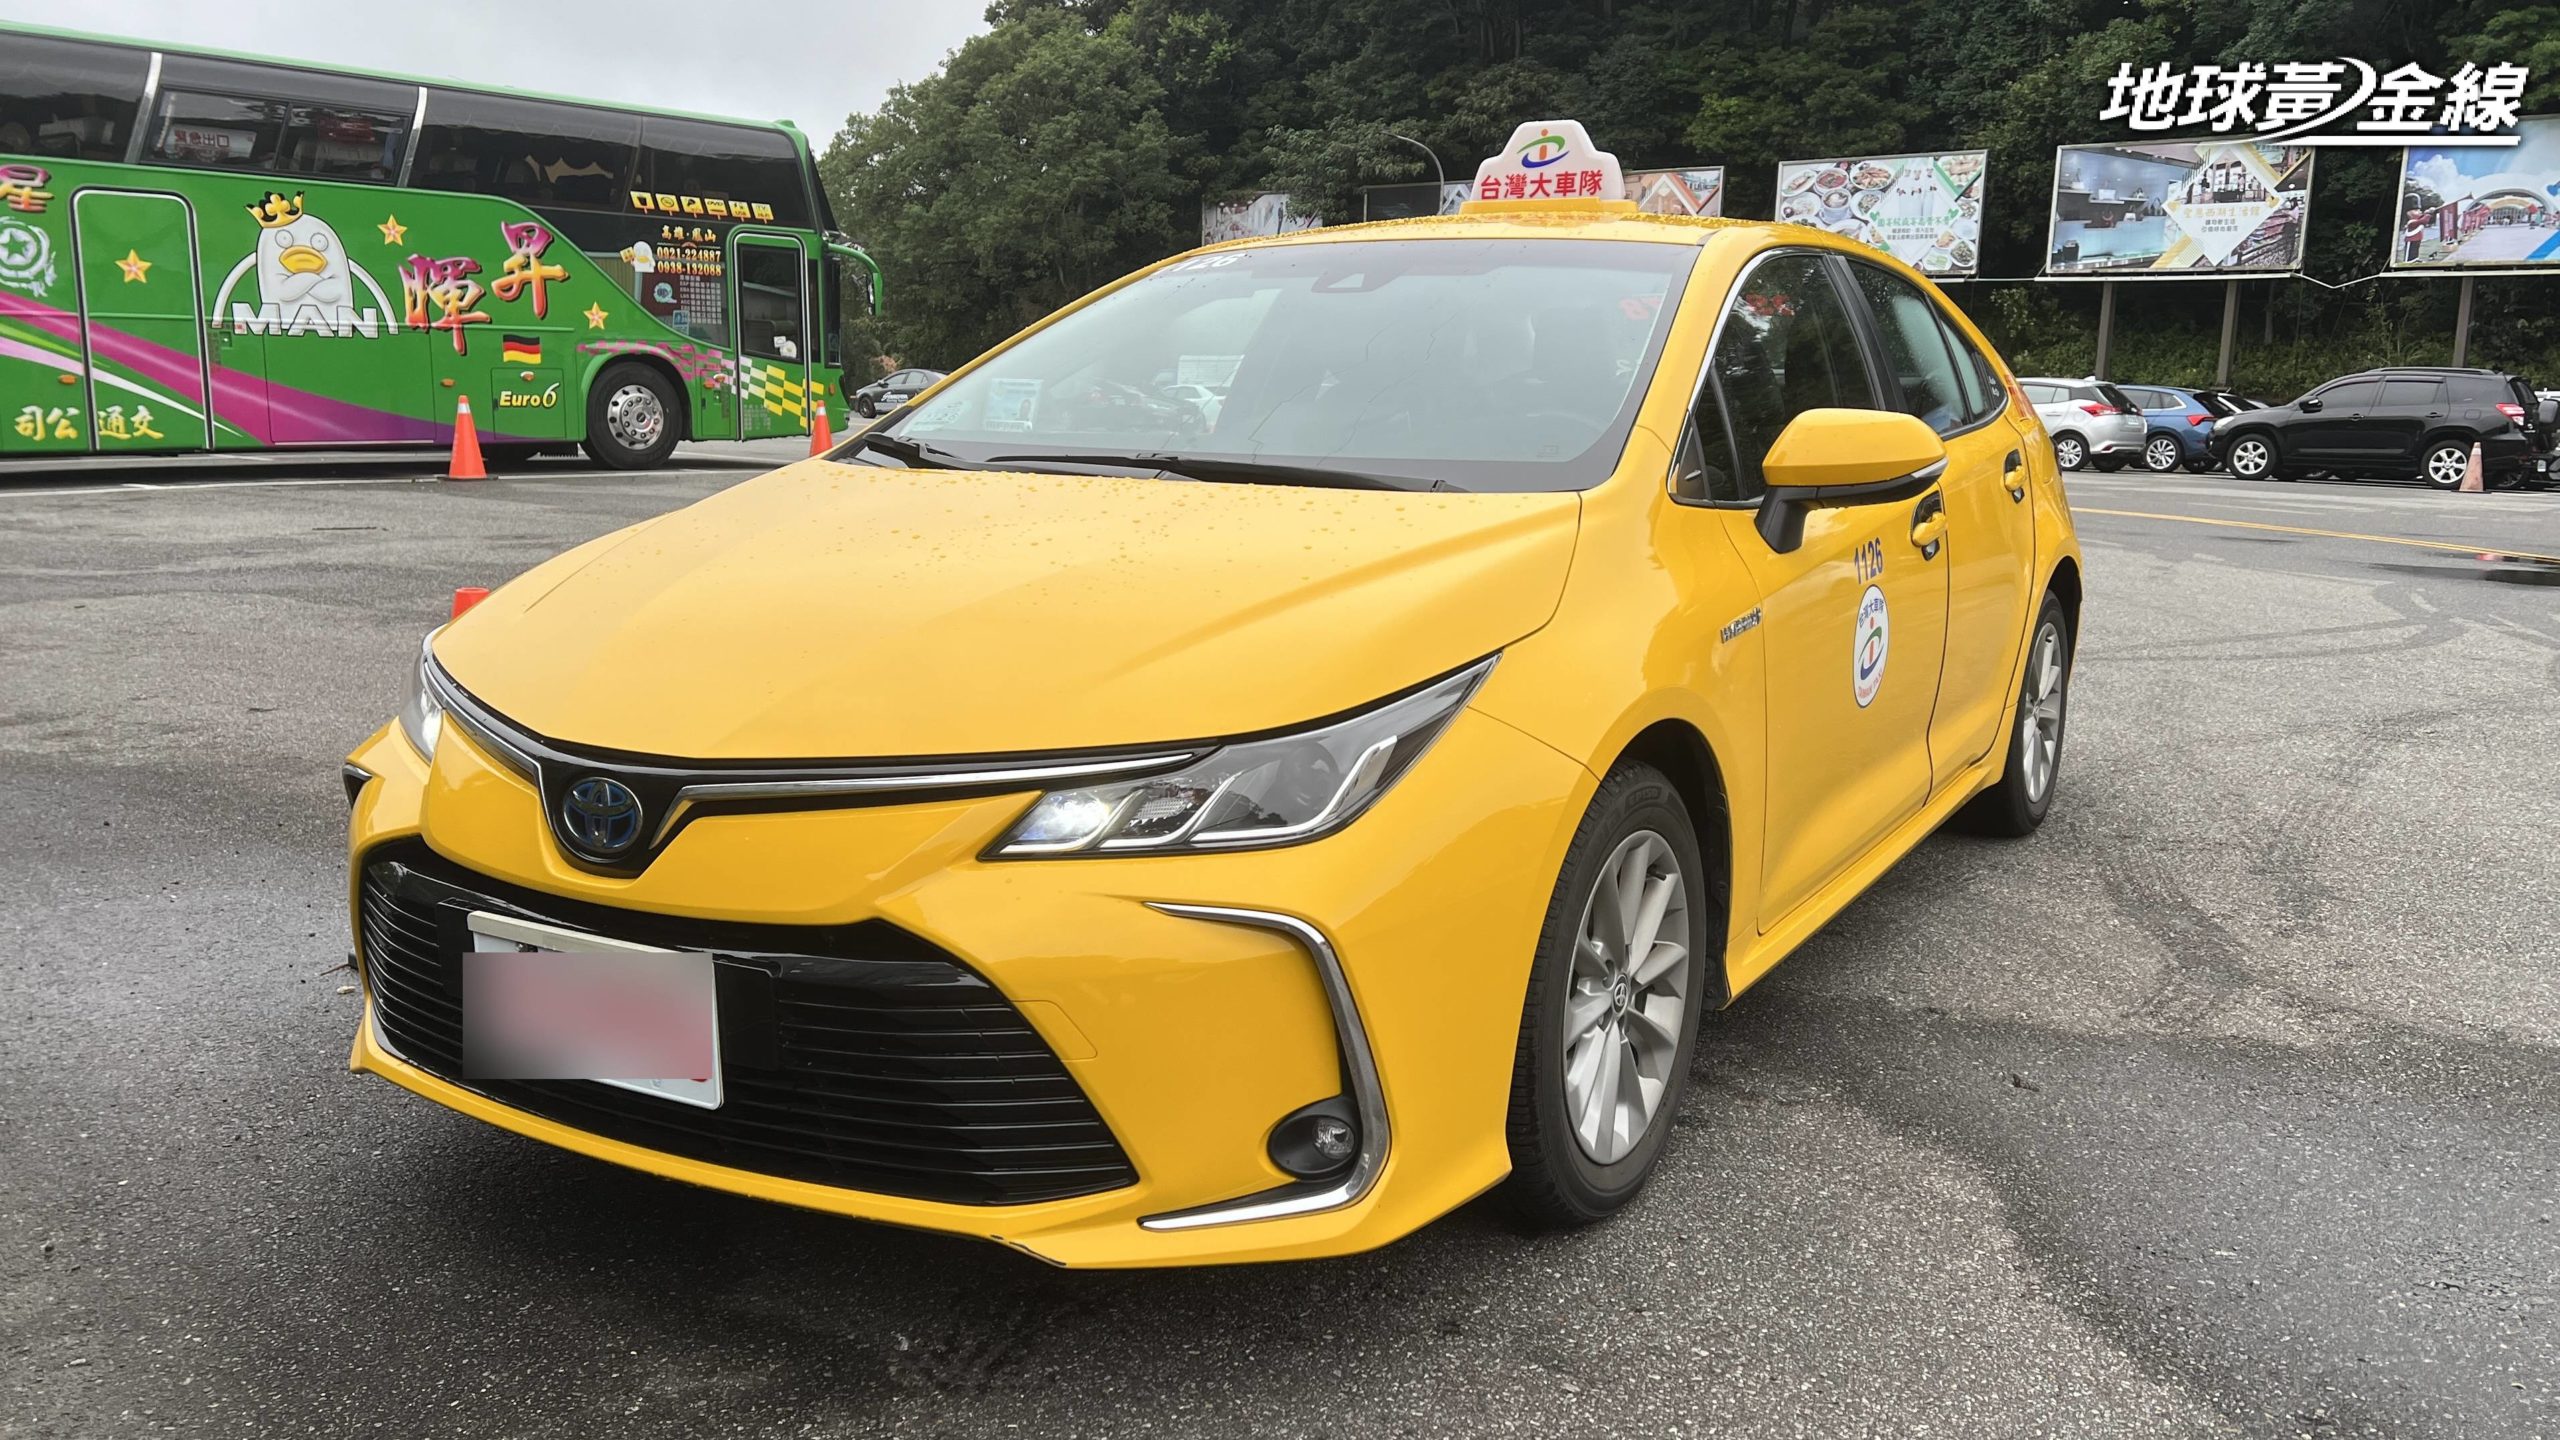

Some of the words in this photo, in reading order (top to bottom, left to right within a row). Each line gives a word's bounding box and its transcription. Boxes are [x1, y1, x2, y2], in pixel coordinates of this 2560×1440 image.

[173, 129, 230, 148] 緊急出口
[1481, 169, 1604, 200] 台灣大車隊
[657, 261, 722, 276] 0938-132088
[231, 302, 379, 339] MAN
[1854, 537, 1884, 585] 1126
